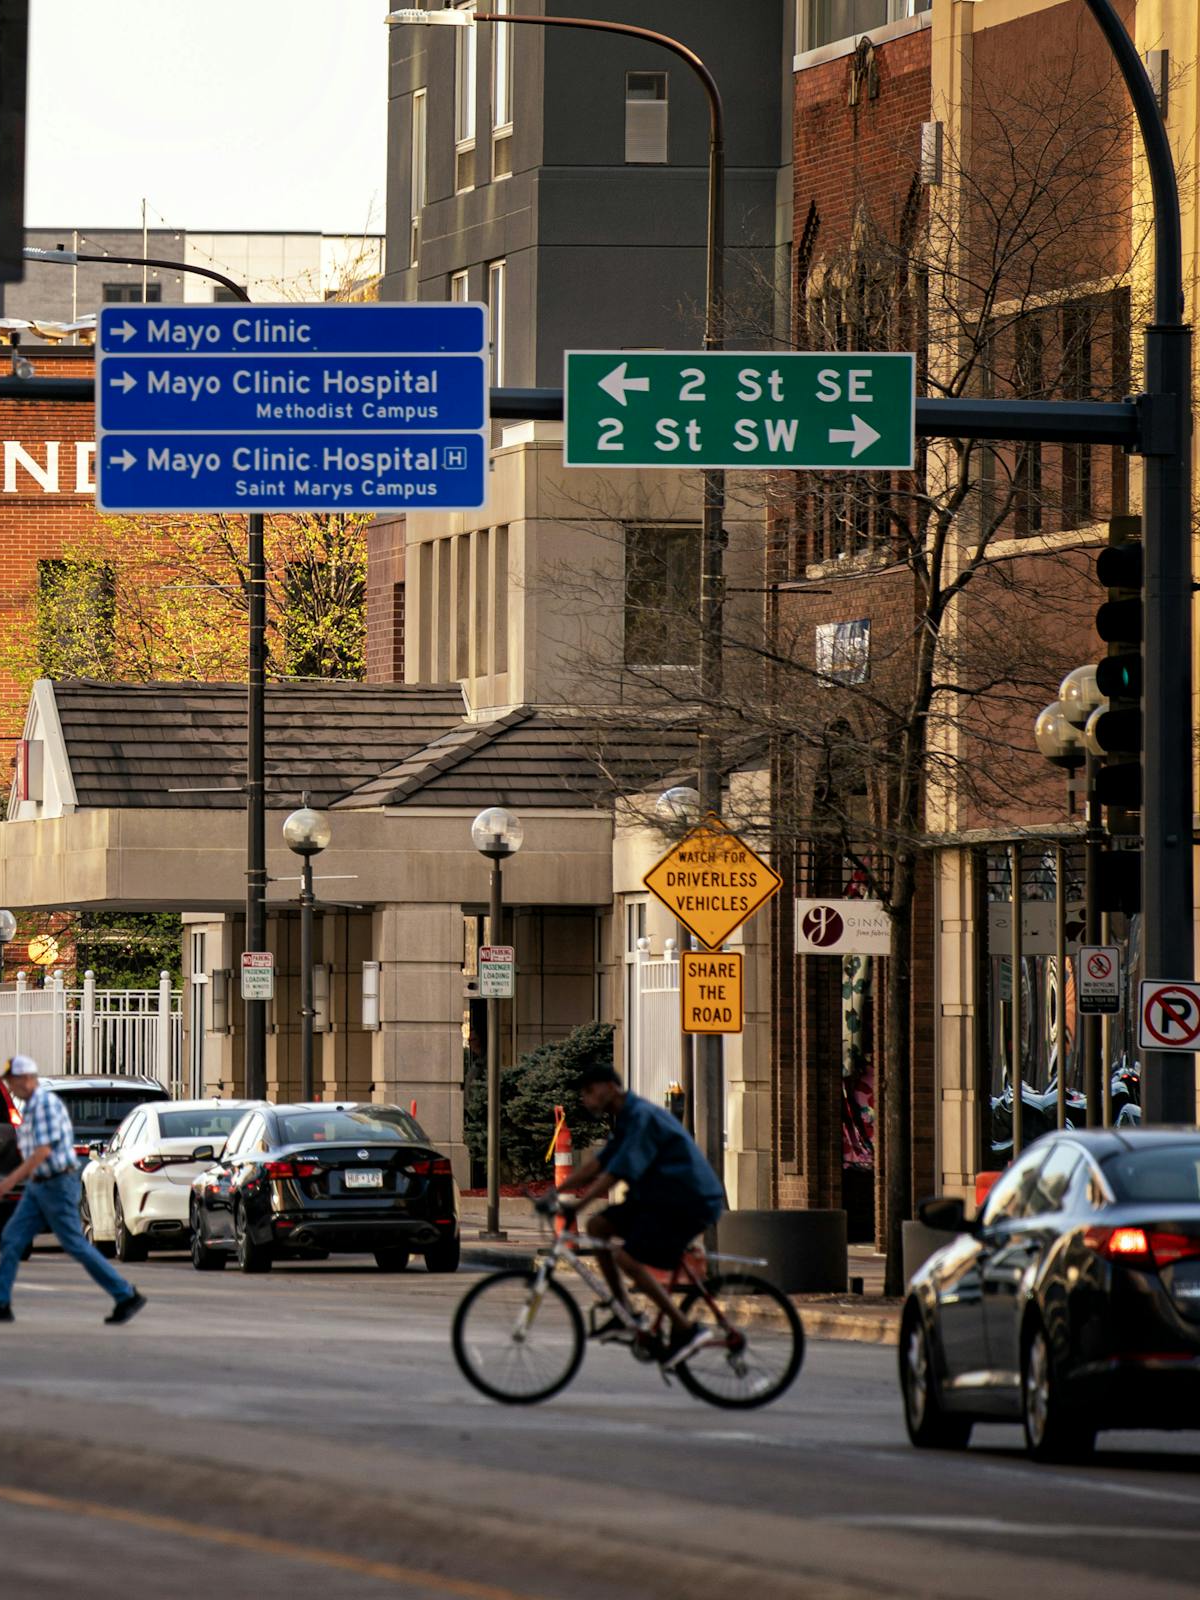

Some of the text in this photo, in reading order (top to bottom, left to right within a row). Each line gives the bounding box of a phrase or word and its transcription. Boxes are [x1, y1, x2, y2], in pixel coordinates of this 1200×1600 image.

[147, 318, 311, 350] Mayo Clinic
[147, 370, 437, 401] Mayo Clinic Hospital
[679, 368, 873, 402] 2 St SE
[256, 403, 438, 422] Methodist Campus
[597, 418, 799, 452] 2 St SW
[147, 447, 462, 479] Mayo Clinic Hospital H
[235, 480, 437, 500] Saint Marys Campus
[678, 851, 746, 864] WATCH FOR
[666, 872, 758, 888] DRIVERLESS
[676, 896, 749, 912] VEHICLES
[688, 962, 737, 978] SHARE
[699, 985, 726, 1000] THE
[692, 1007, 732, 1023] ROAD
